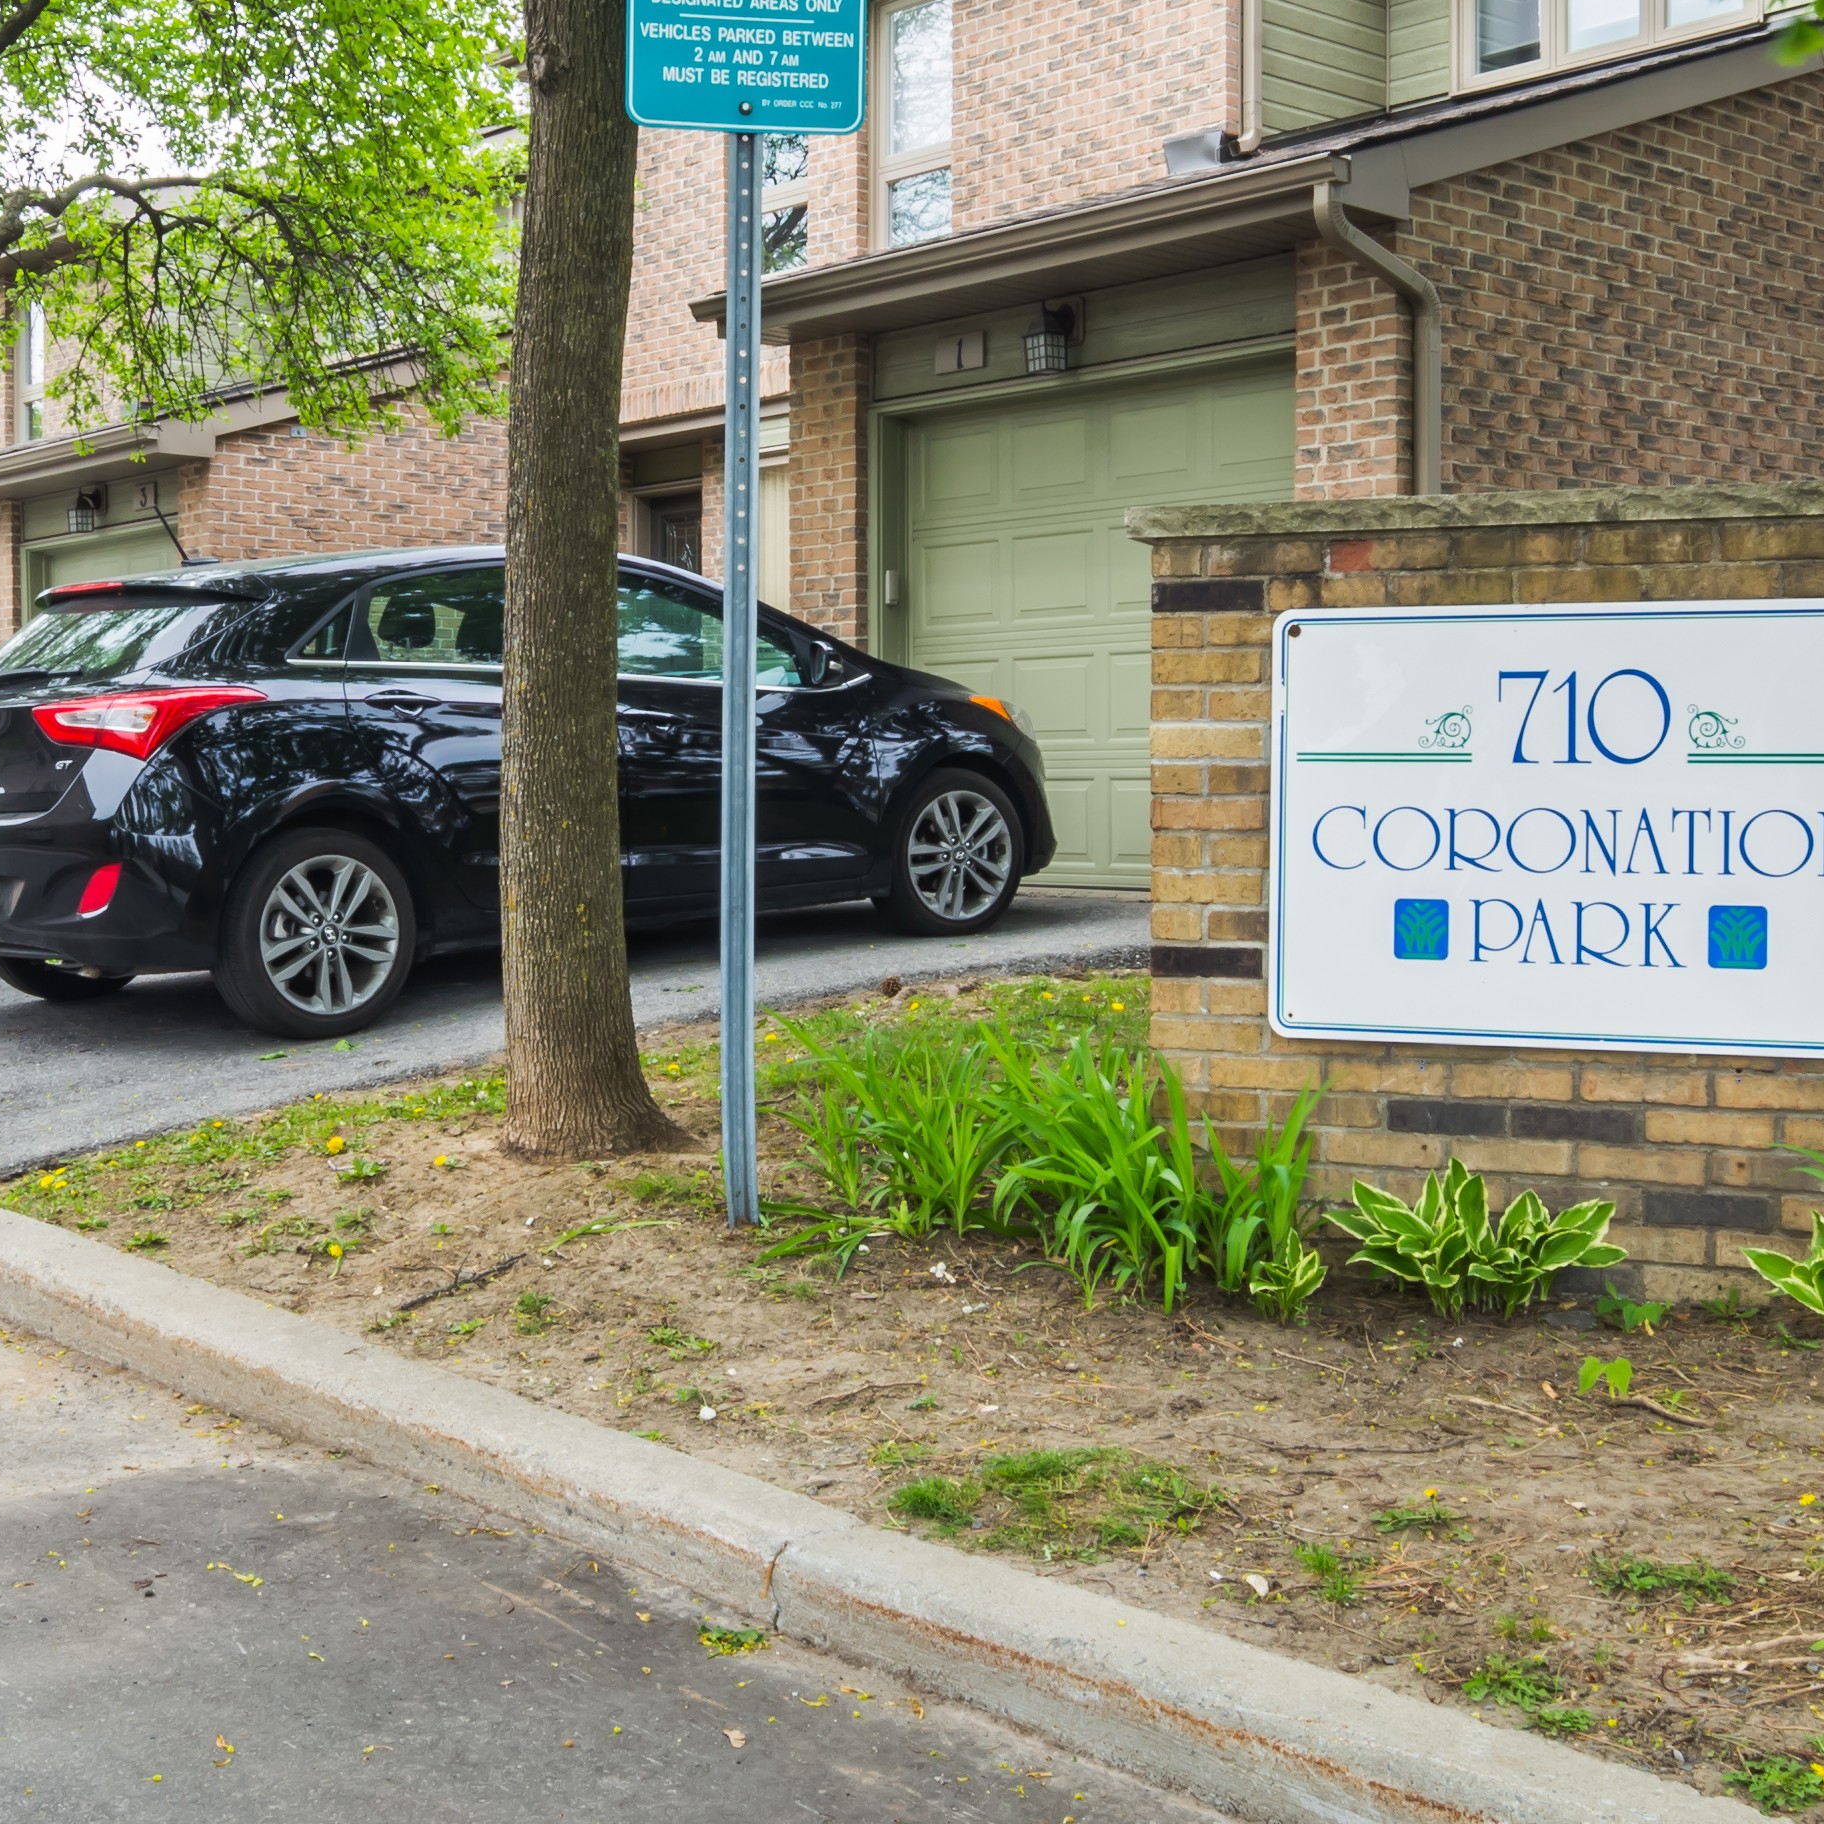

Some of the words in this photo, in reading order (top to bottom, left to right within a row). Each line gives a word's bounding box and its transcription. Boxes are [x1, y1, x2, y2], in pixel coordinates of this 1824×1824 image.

[639, 22, 711, 42] VEHICLES
[718, 27, 776, 45] PARKED
[782, 30, 855, 48] BETWEEN
[693, 46, 703, 63] 2
[707, 50, 726, 63] AM
[732, 49, 763, 66] AND
[769, 51, 779, 66] 7
[781, 54, 799, 67] AM
[662, 66, 704, 83] MUST
[710, 69, 730, 85] BE
[737, 70, 829, 89] REGISTERED
[761, 99, 770, 107] BY
[773, 99, 797, 108] ORDER
[957, 337, 964, 370] 1
[140, 487, 148, 507] 3
[1498, 668, 1671, 764] 710
[55, 759, 74, 770] GT
[1469, 898, 1688, 968] PARK
